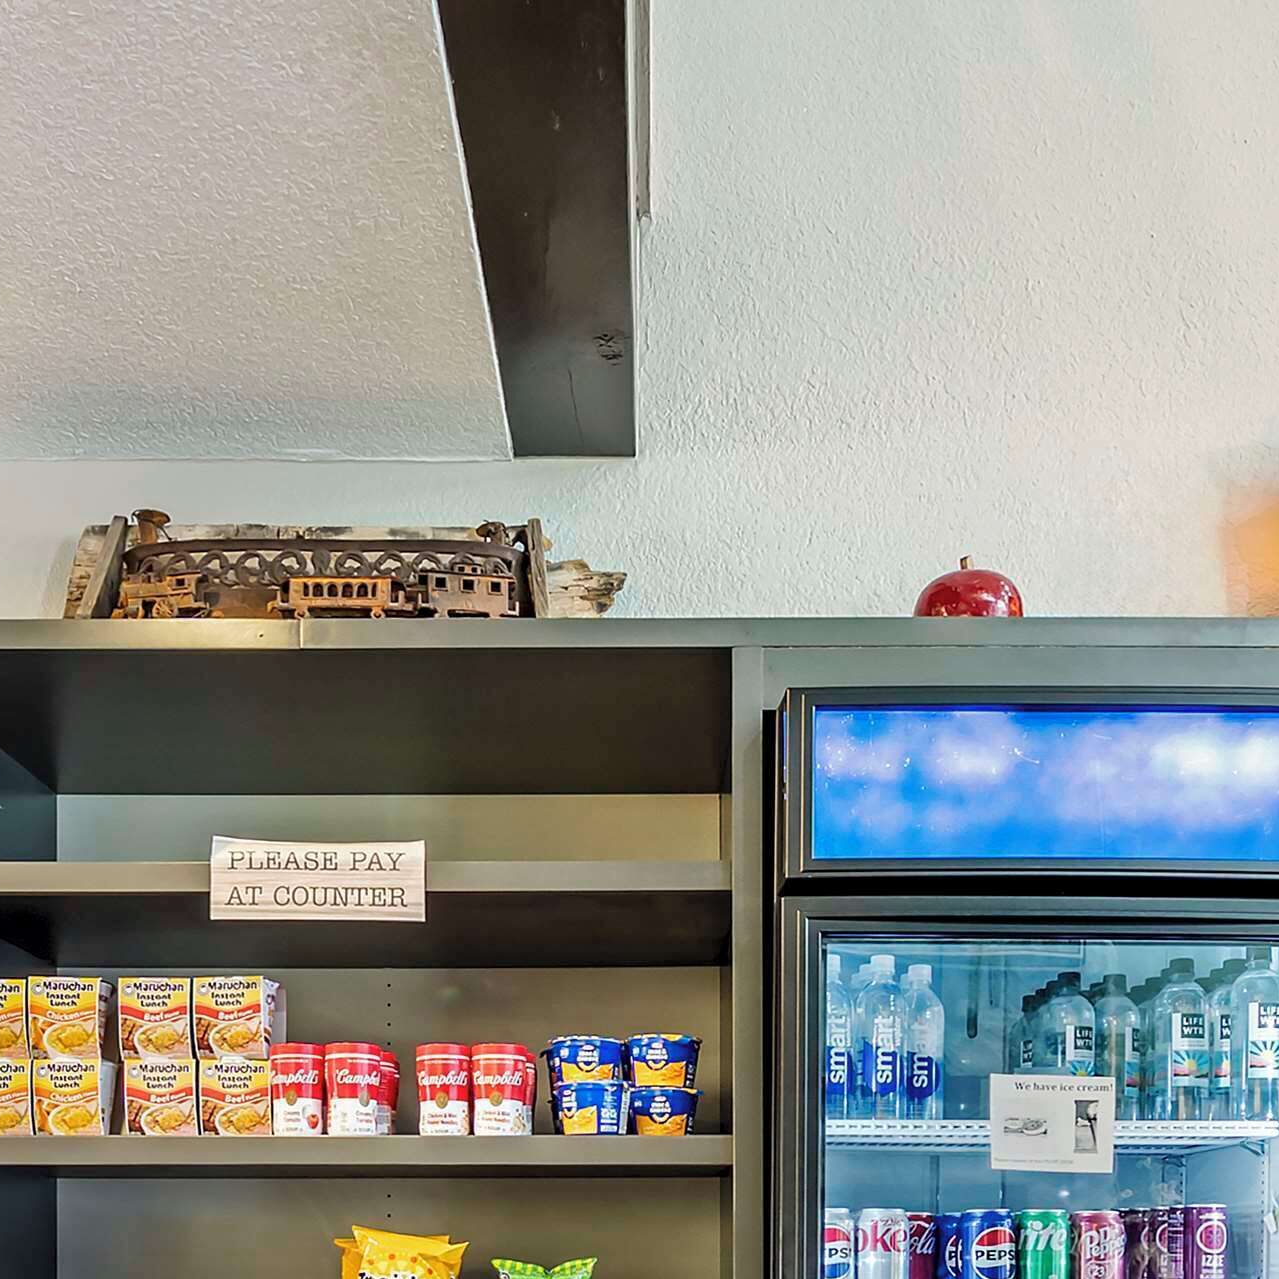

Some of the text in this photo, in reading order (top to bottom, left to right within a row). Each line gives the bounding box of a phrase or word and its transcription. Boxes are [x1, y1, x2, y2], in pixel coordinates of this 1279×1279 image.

[227, 850, 406, 872] PLEASE PAY
[224, 886, 408, 907] AT COUNTER
[43, 982, 94, 992] Maruchan
[133, 982, 184, 992] Maruchan
[208, 981, 257, 990] Maruchan
[46, 992, 80, 1000] Instant
[141, 1000, 168, 1008] Lunch
[215, 999, 242, 1007] Lunch
[1183, 1017, 1203, 1026] LIFE
[876, 1016, 893, 1084] smart
[47, 1063, 95, 1073] Maruchan
[139, 1063, 189, 1073] Maruchan
[214, 1063, 264, 1073] Maruchan
[1015, 1082, 1113, 1093] We have ice cream!
[975, 1249, 1015, 1261] PEPS
